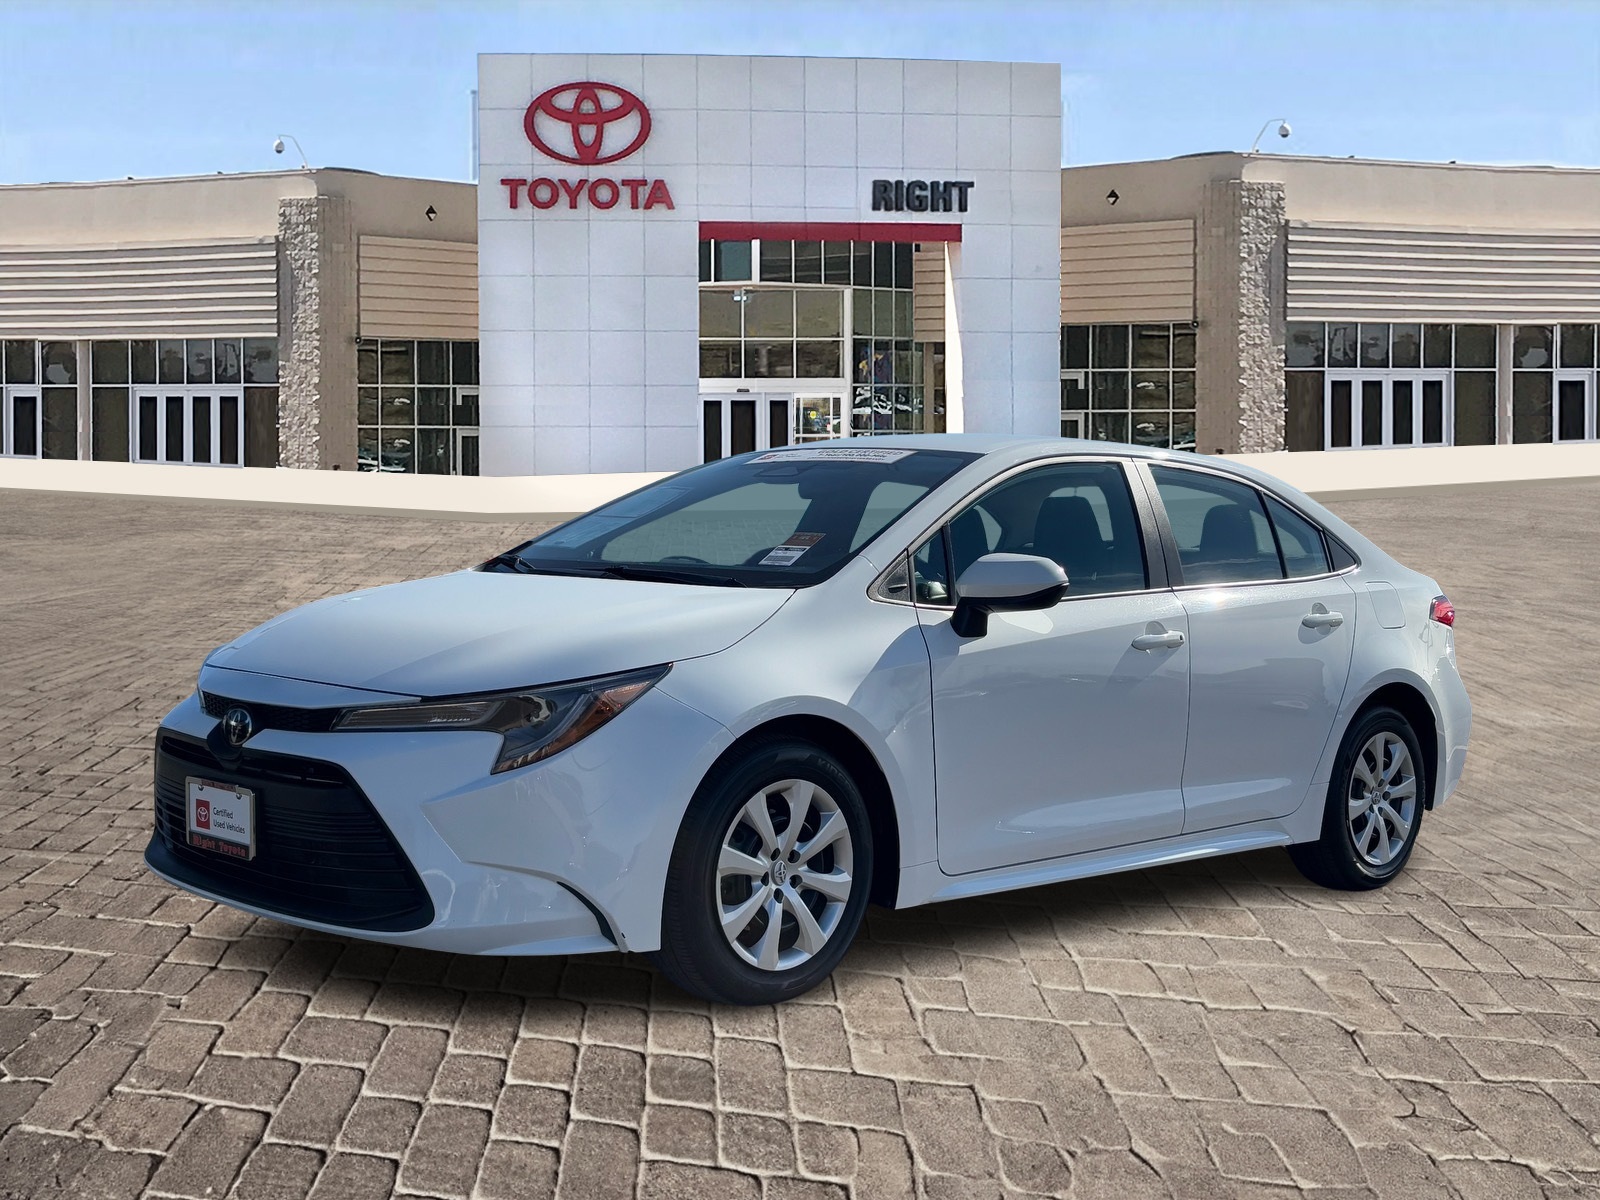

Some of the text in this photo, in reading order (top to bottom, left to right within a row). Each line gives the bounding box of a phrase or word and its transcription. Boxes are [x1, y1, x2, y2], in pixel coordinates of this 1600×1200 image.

[500, 179, 675, 209] TOYOTA
[871, 179, 975, 212] RIGHT
[213, 807, 233, 819] Certified
[213, 820, 246, 834] Used Vehicles
[220, 842, 246, 856] Toyota
